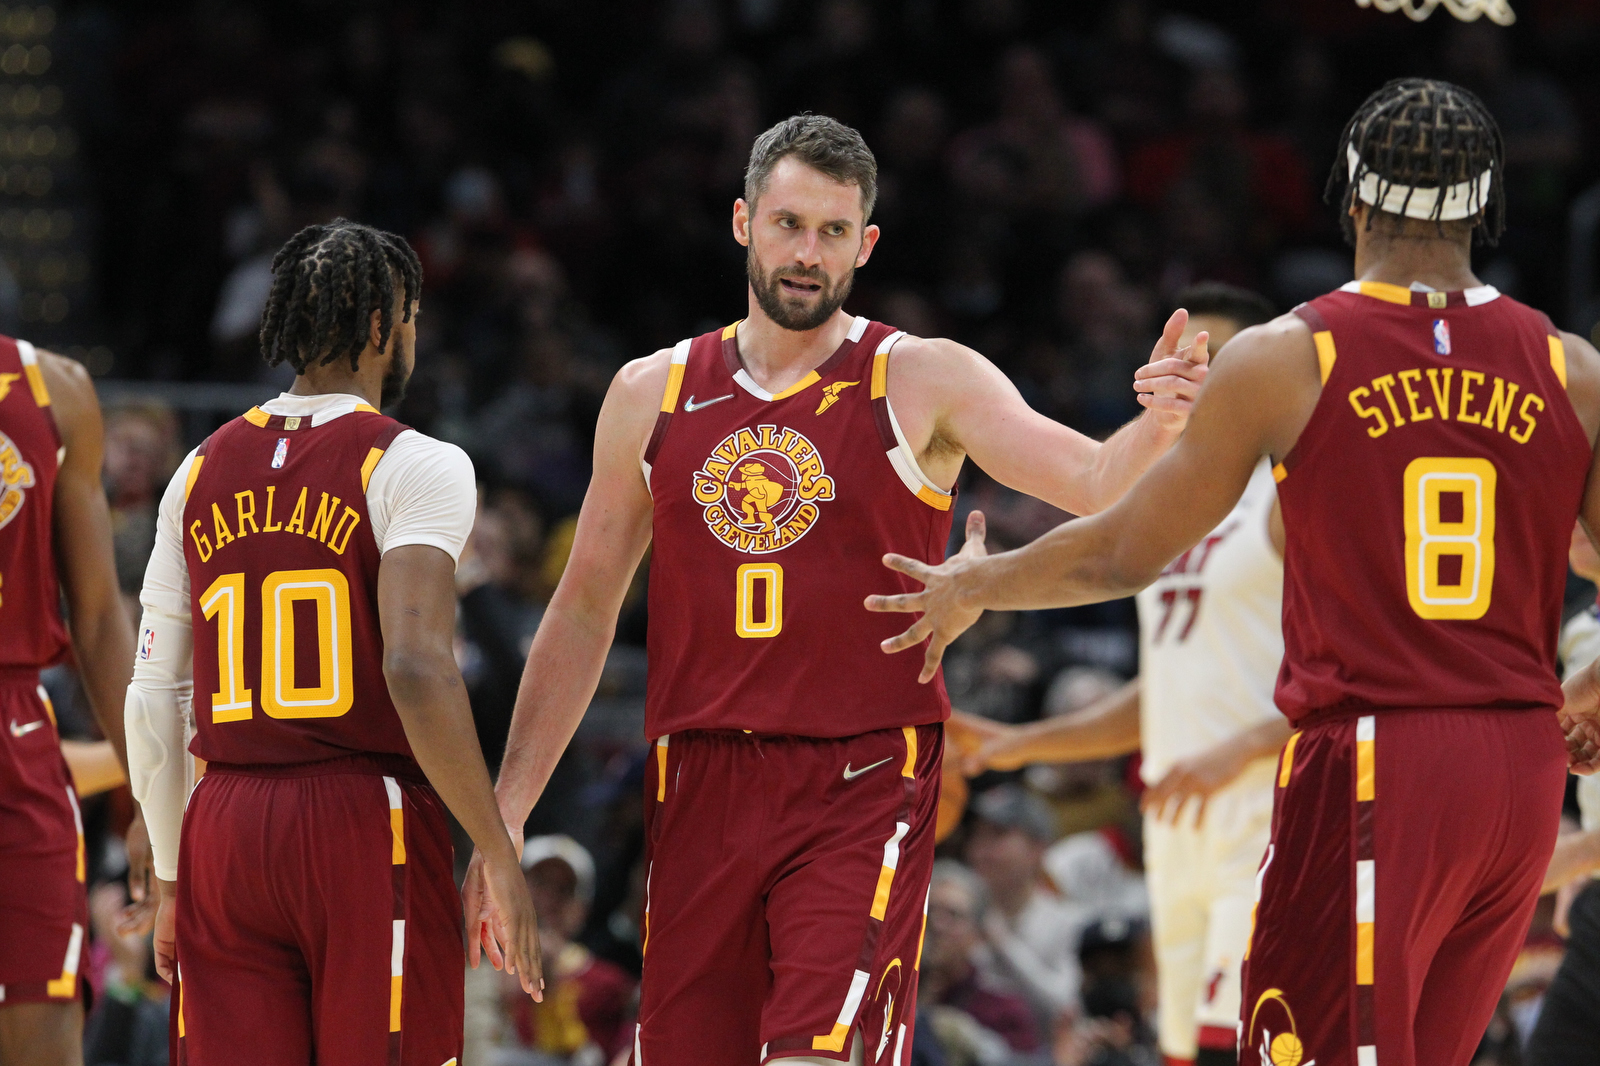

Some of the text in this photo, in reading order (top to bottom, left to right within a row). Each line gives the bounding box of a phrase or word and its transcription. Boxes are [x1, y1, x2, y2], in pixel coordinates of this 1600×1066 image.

[1348, 368, 1545, 444] STEVENS
[693, 425, 834, 505] CAVALIERS
[189, 485, 361, 563] GARLAND
[704, 501, 819, 554] CLEVELAND
[1403, 457, 1497, 620] 8
[736, 563, 783, 638] 0
[1154, 588, 1203, 643] 77
[199, 568, 354, 724] 10
